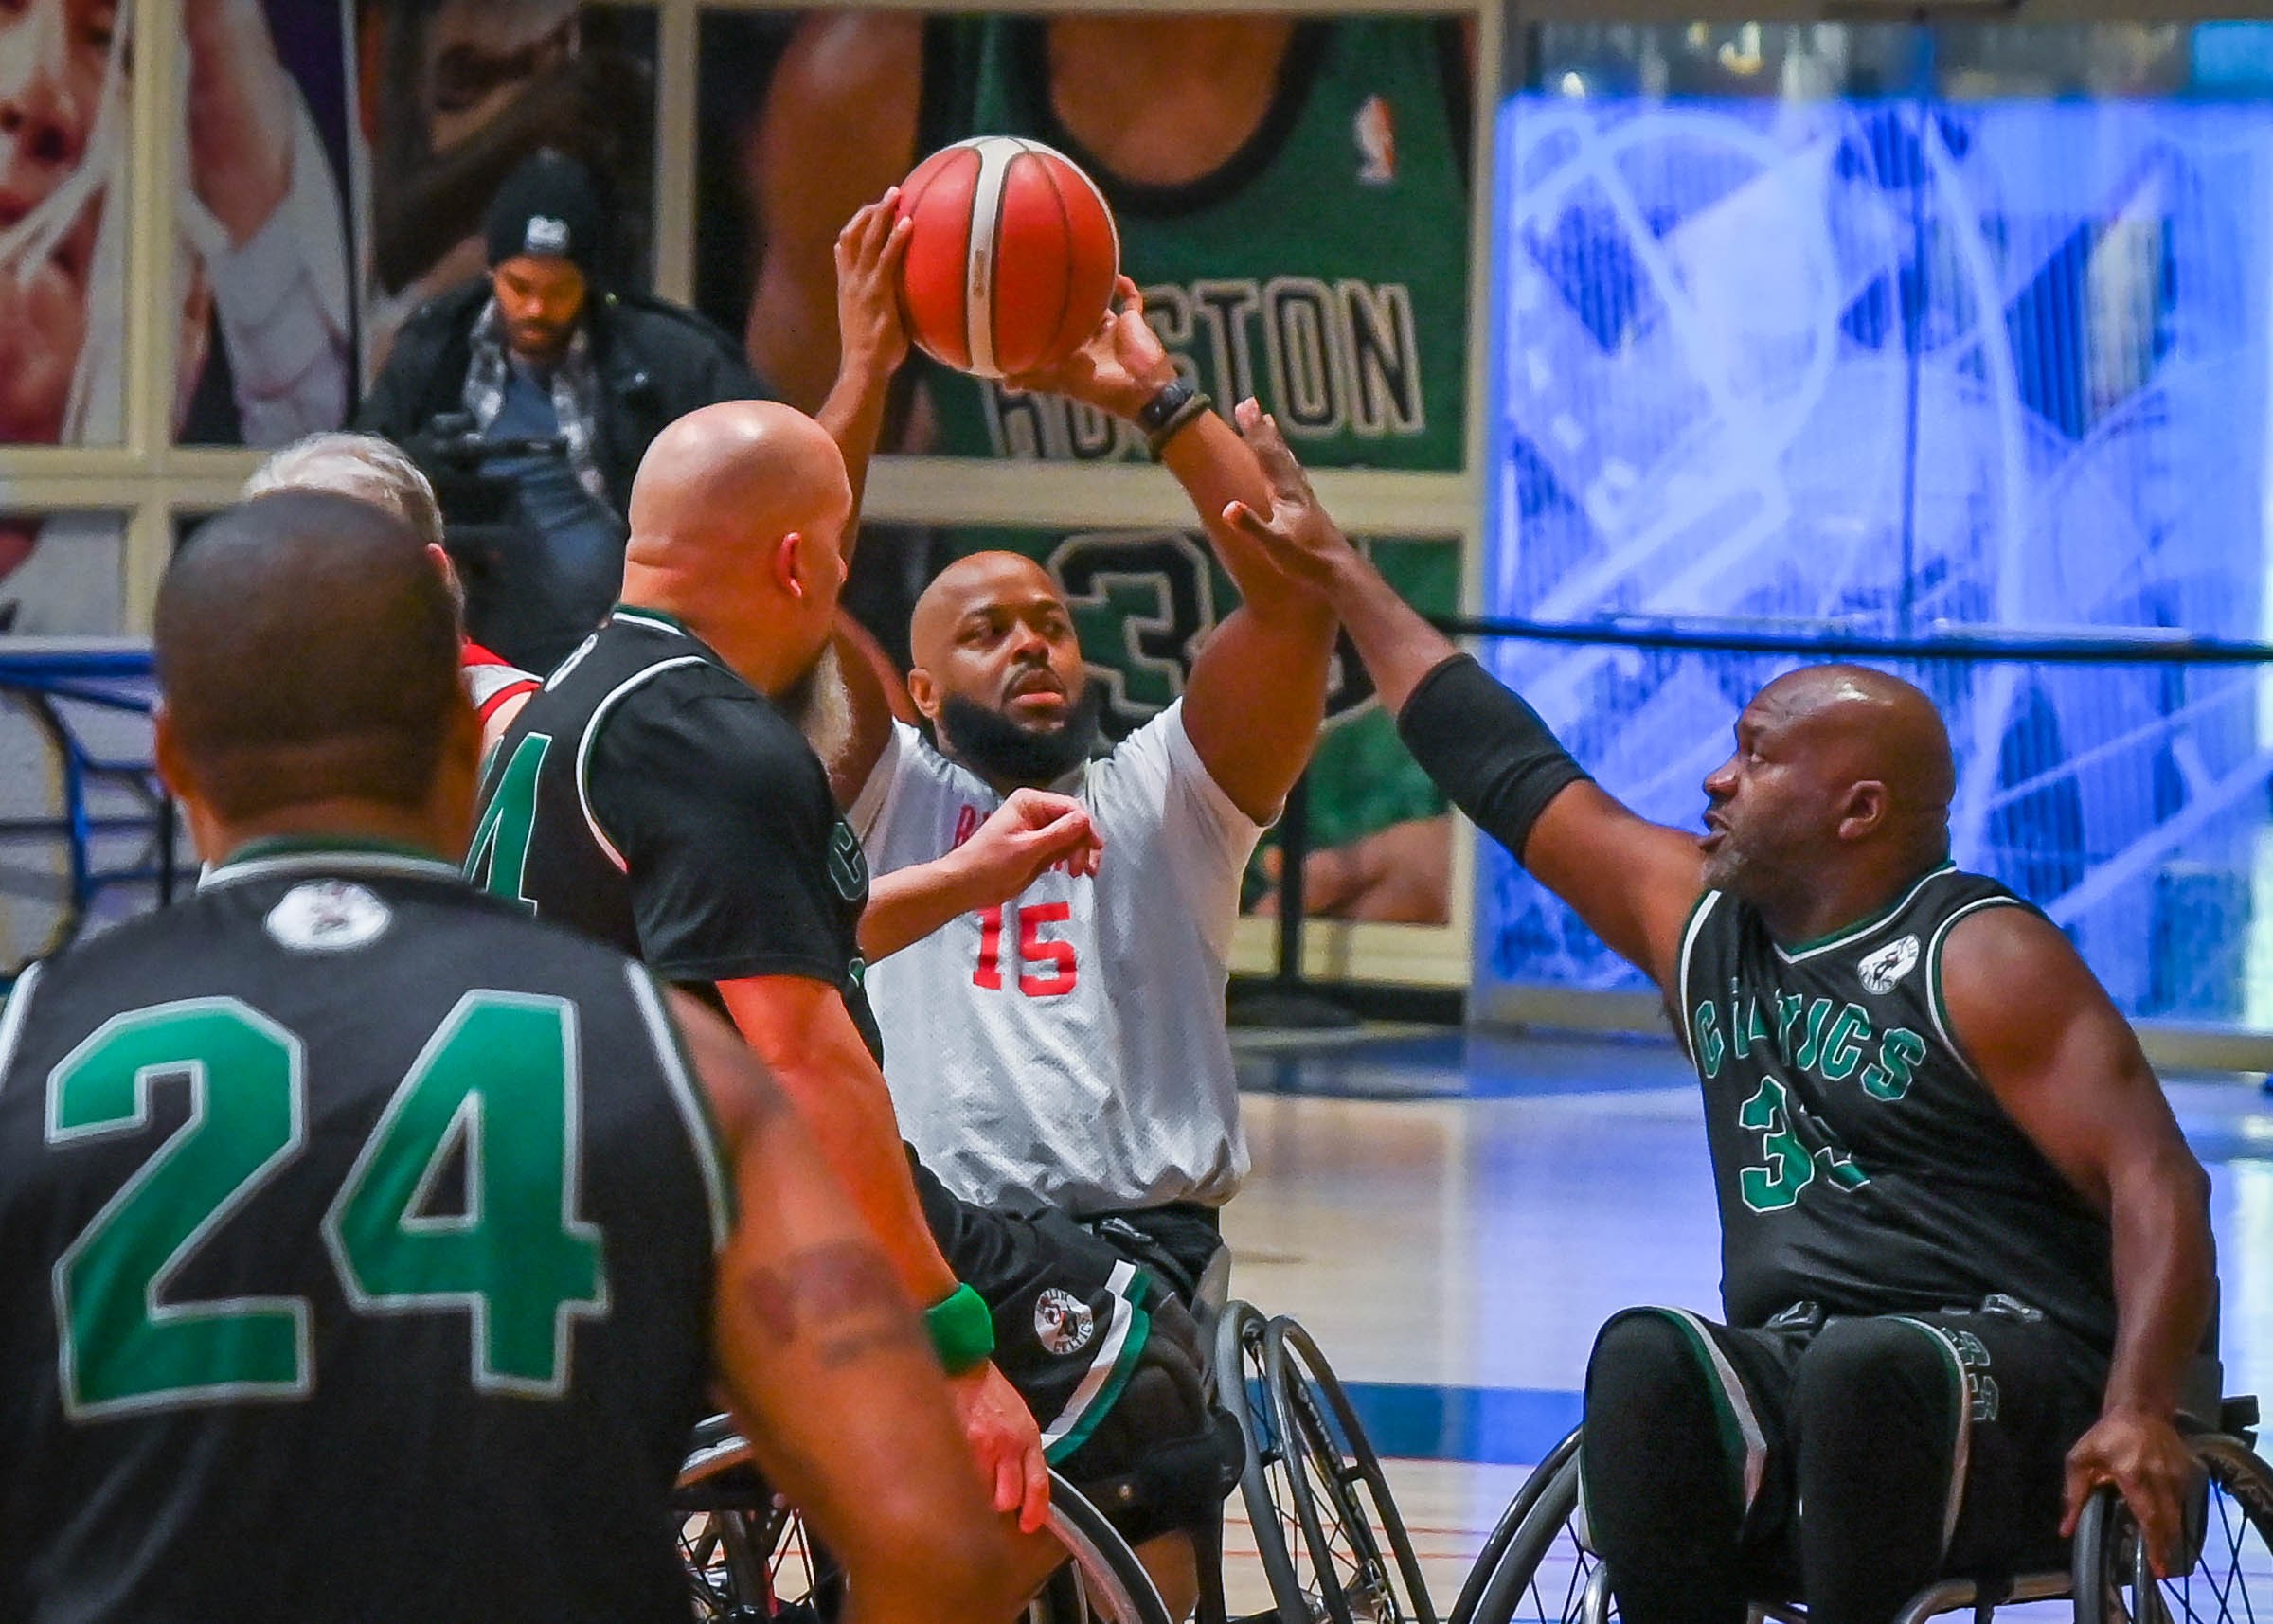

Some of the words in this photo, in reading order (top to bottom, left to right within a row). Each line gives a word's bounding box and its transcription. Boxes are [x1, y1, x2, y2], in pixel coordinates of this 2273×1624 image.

[983, 273, 1426, 459] STON
[972, 901, 1078, 998] 15
[44, 987, 613, 1420] 24
